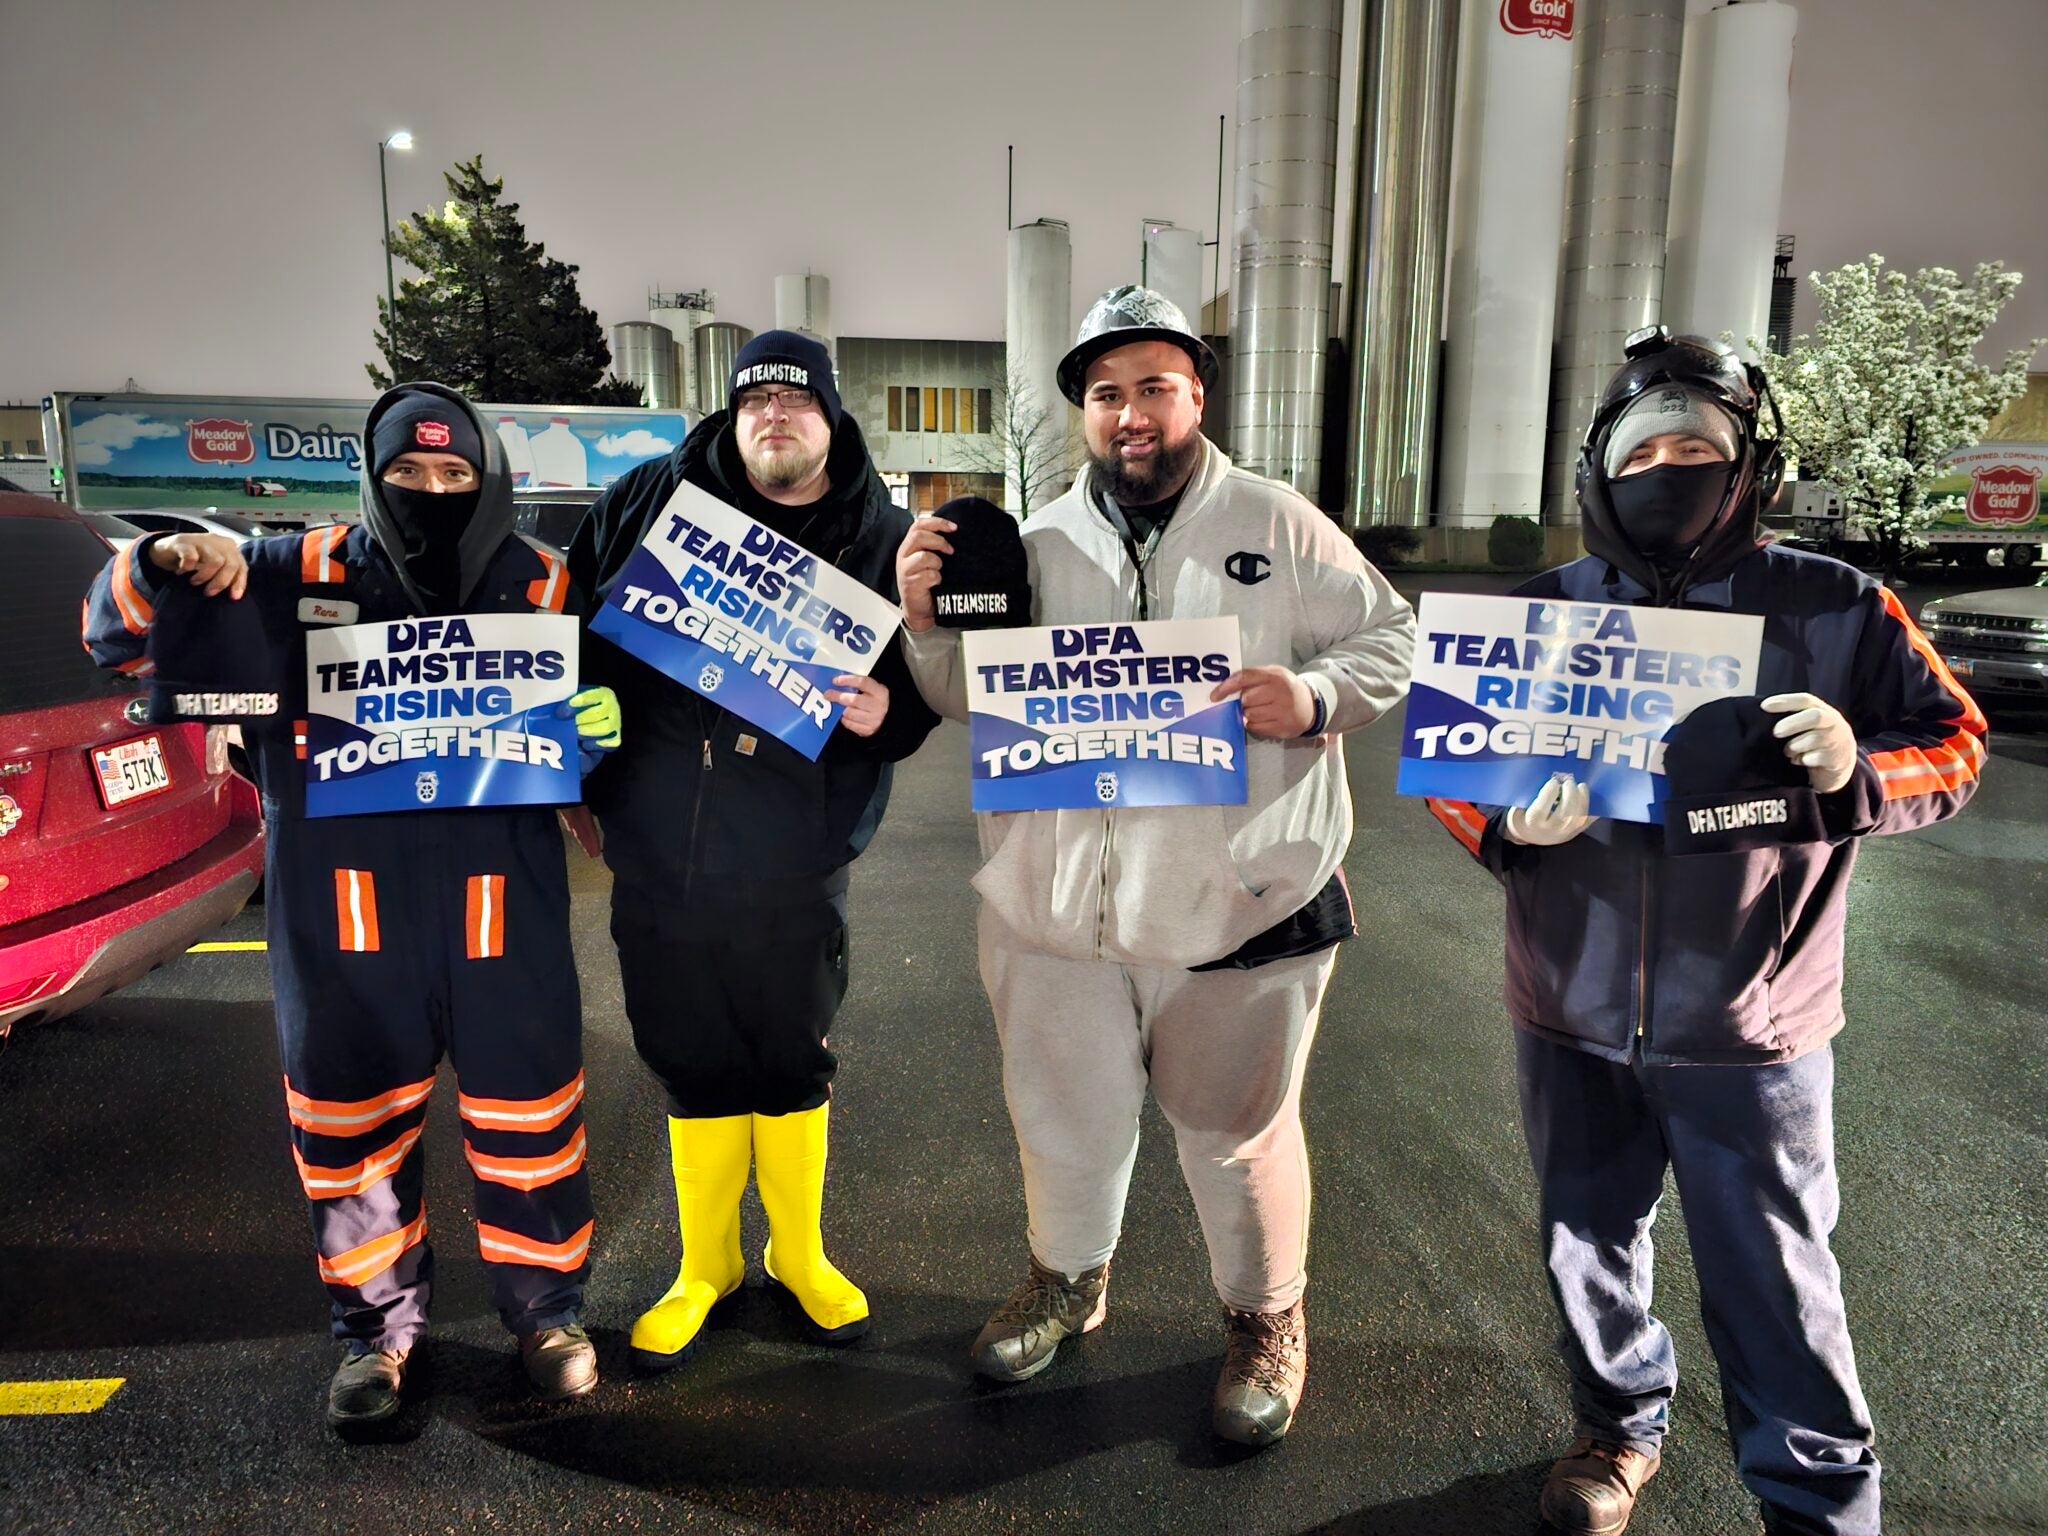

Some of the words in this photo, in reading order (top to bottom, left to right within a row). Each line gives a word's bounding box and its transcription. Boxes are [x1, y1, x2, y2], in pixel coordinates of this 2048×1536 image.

[1529, 0, 1566, 18] Gold
[752, 363, 808, 386] TEAMSTERS
[1663, 404, 1687, 413] 222
[194, 428, 246, 441] Meadow
[206, 440, 237, 452] Gold
[1979, 481, 2032, 495] Meadow
[1988, 494, 2020, 509] Gold
[740, 524, 818, 592] DFA
[665, 513, 877, 655] TEAMSTERS
[679, 563, 820, 662] RISING
[952, 593, 1008, 615] TEAMSTERS
[387, 618, 475, 654] DFA
[1524, 602, 1637, 643] DFA
[621, 585, 832, 730] TOGETHER
[1051, 625, 1144, 658] DFA
[316, 650, 565, 693] TEAMSTERS
[978, 653, 1231, 693] TEAMSTERS
[1428, 632, 1741, 690] TEAMSTERS
[202, 693, 279, 715] TEAMSTERS
[355, 685, 512, 725] RISING
[1024, 690, 1185, 726] RISING
[1475, 674, 1674, 726] RISING
[313, 726, 565, 782] TOGETHER
[982, 729, 1236, 779] TOGETHER
[1687, 807, 1717, 834] DFA
[1714, 799, 1787, 830] TEAMSTERS
